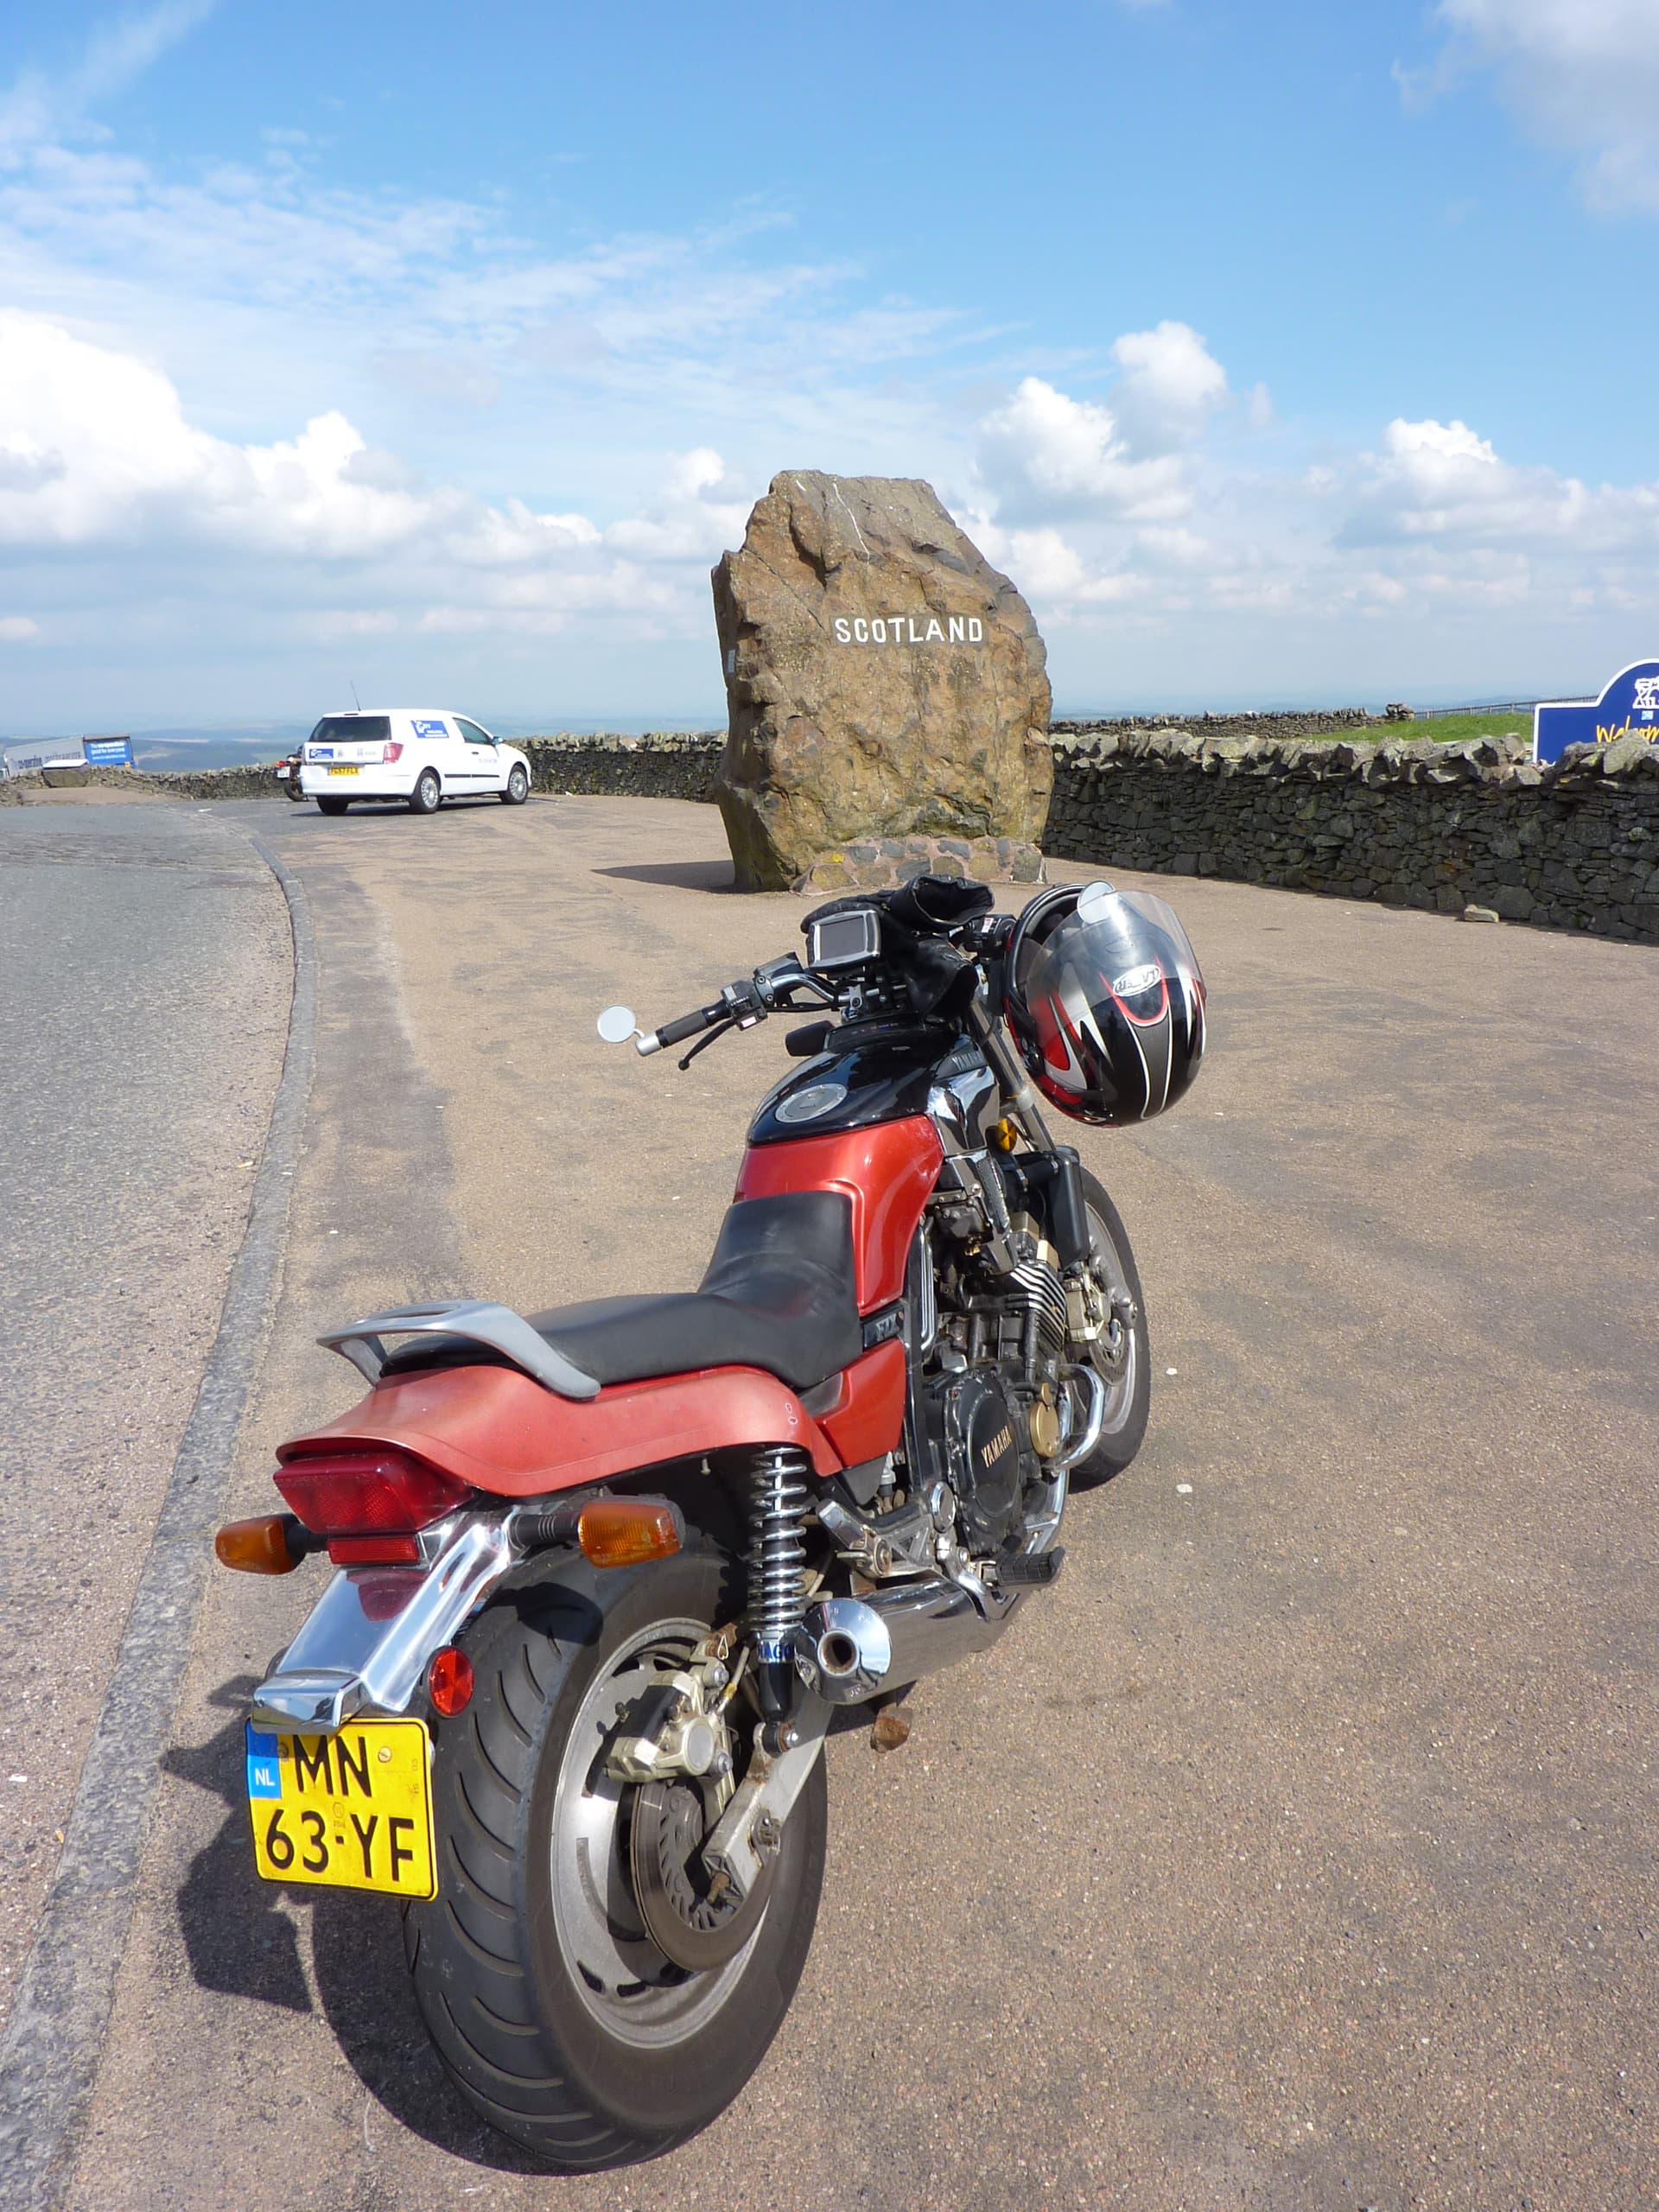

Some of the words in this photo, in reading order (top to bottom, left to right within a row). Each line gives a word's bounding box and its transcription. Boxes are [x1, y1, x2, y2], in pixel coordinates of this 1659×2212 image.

[834, 616, 983, 644] SCOTLAND
[981, 1425, 1012, 1468] YAMAHA
[254, 1768, 276, 1787] NL
[292, 1734, 372, 1798] MN
